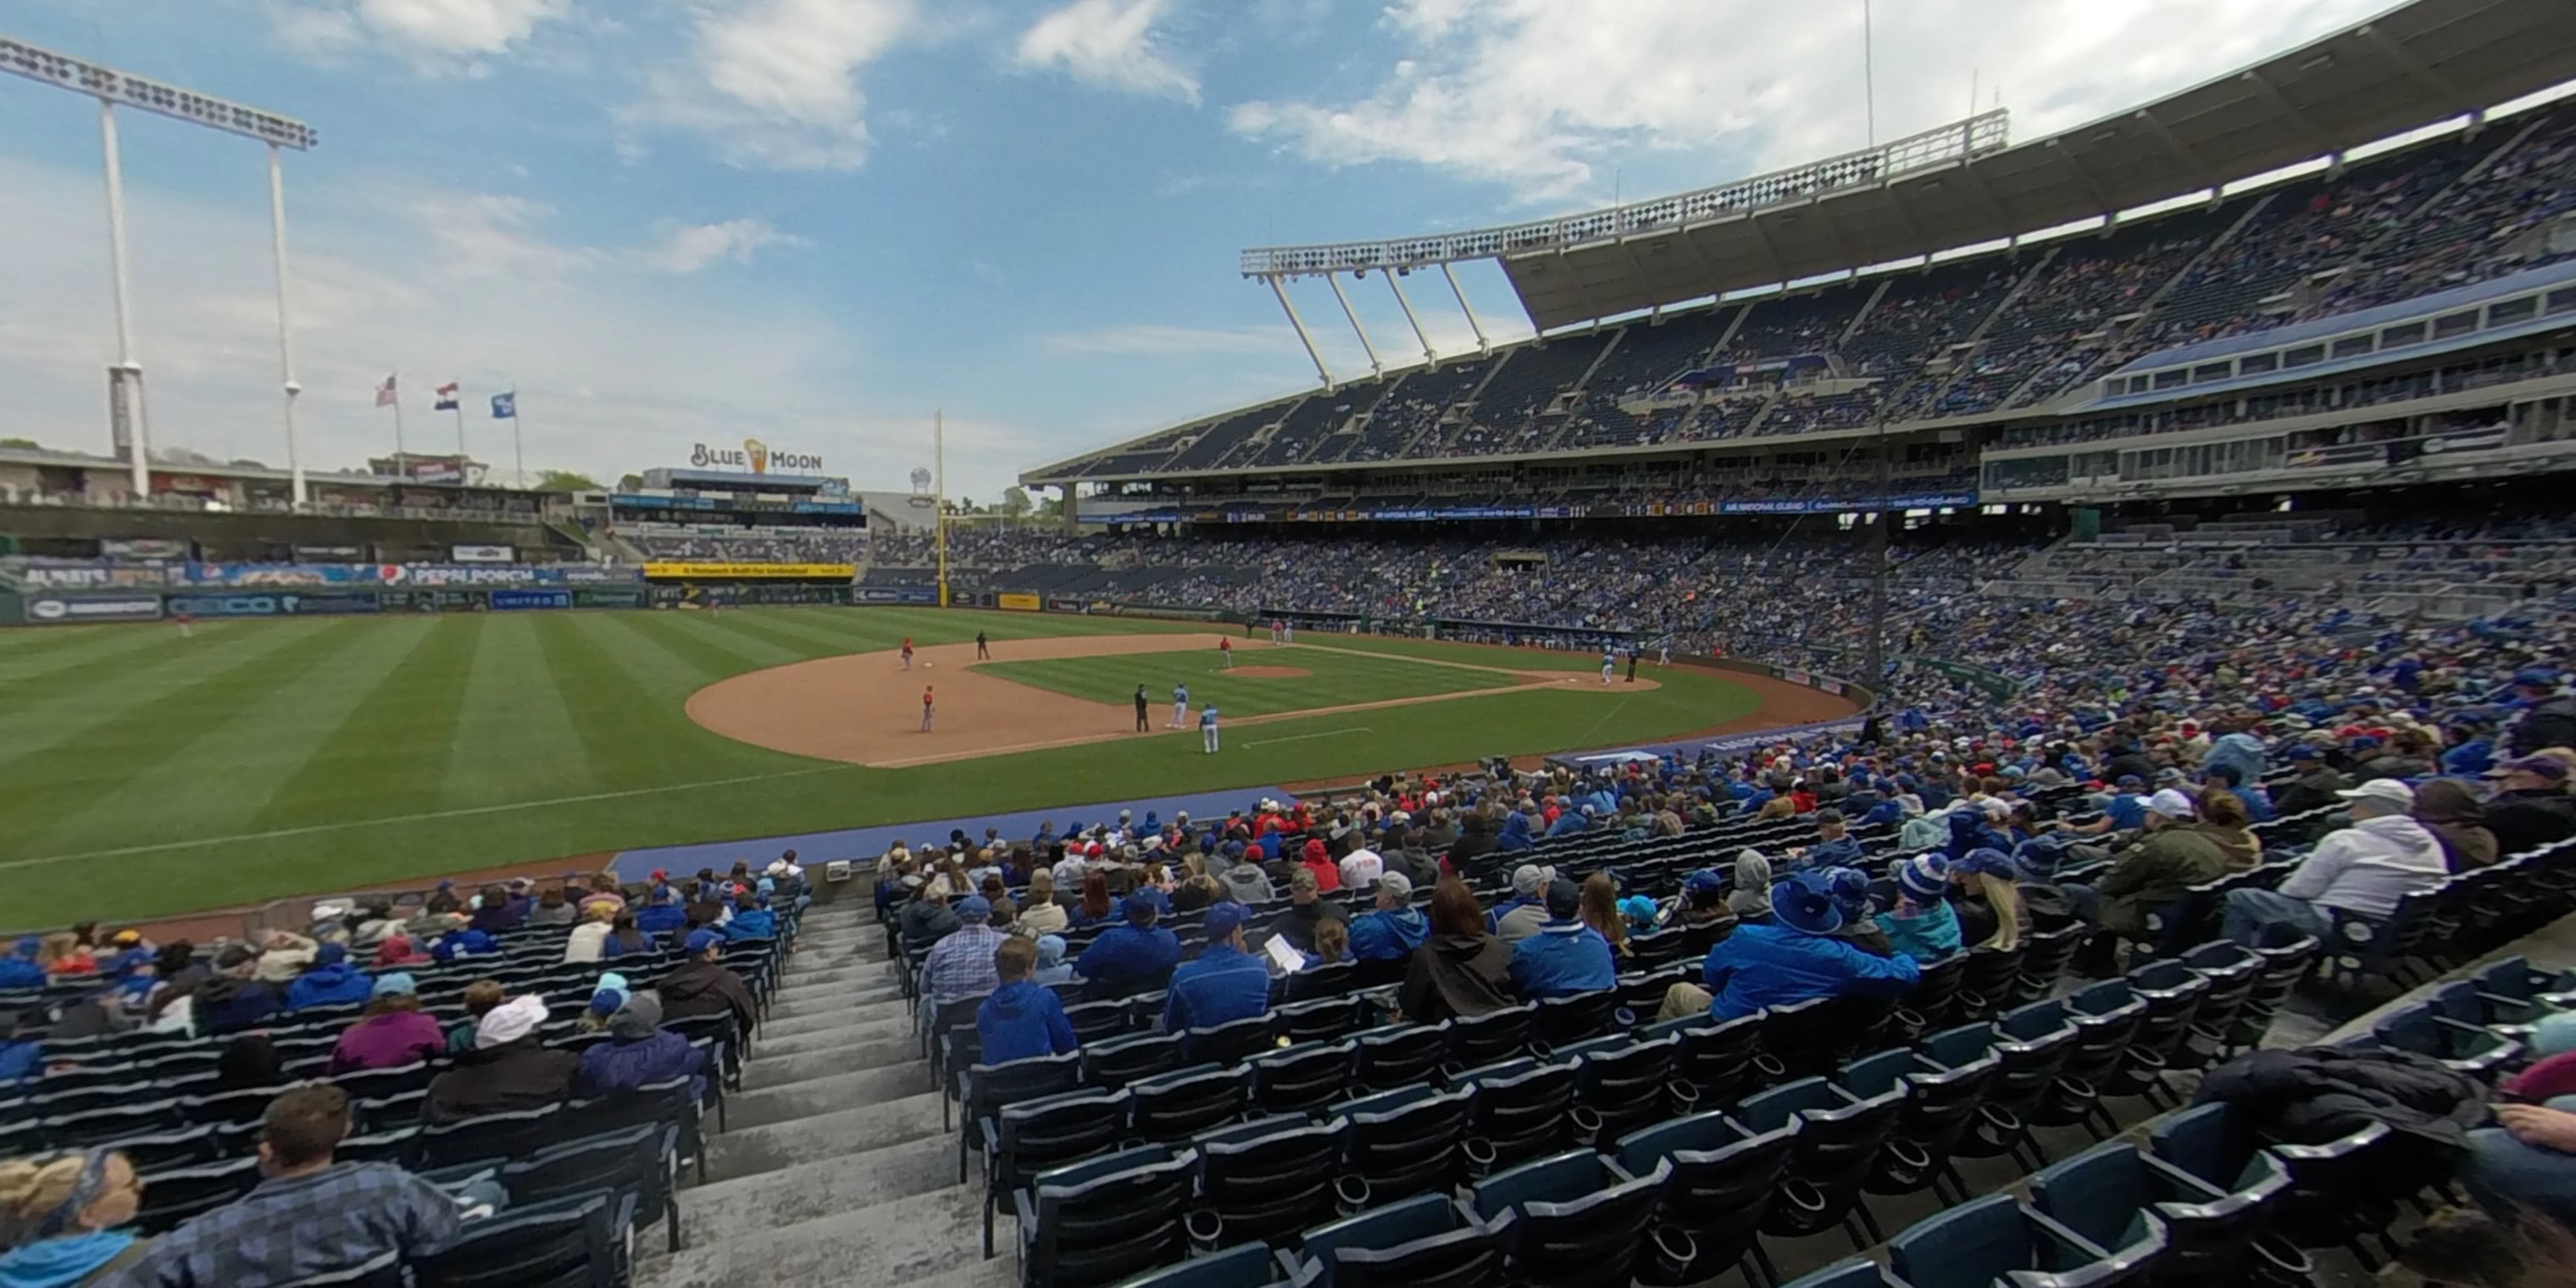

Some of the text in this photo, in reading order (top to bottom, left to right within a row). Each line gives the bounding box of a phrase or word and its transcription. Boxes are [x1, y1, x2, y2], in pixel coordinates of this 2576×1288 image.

[691, 443, 822, 468] BLUE MOON
[415, 569, 535, 583] PEPSI PORCH
